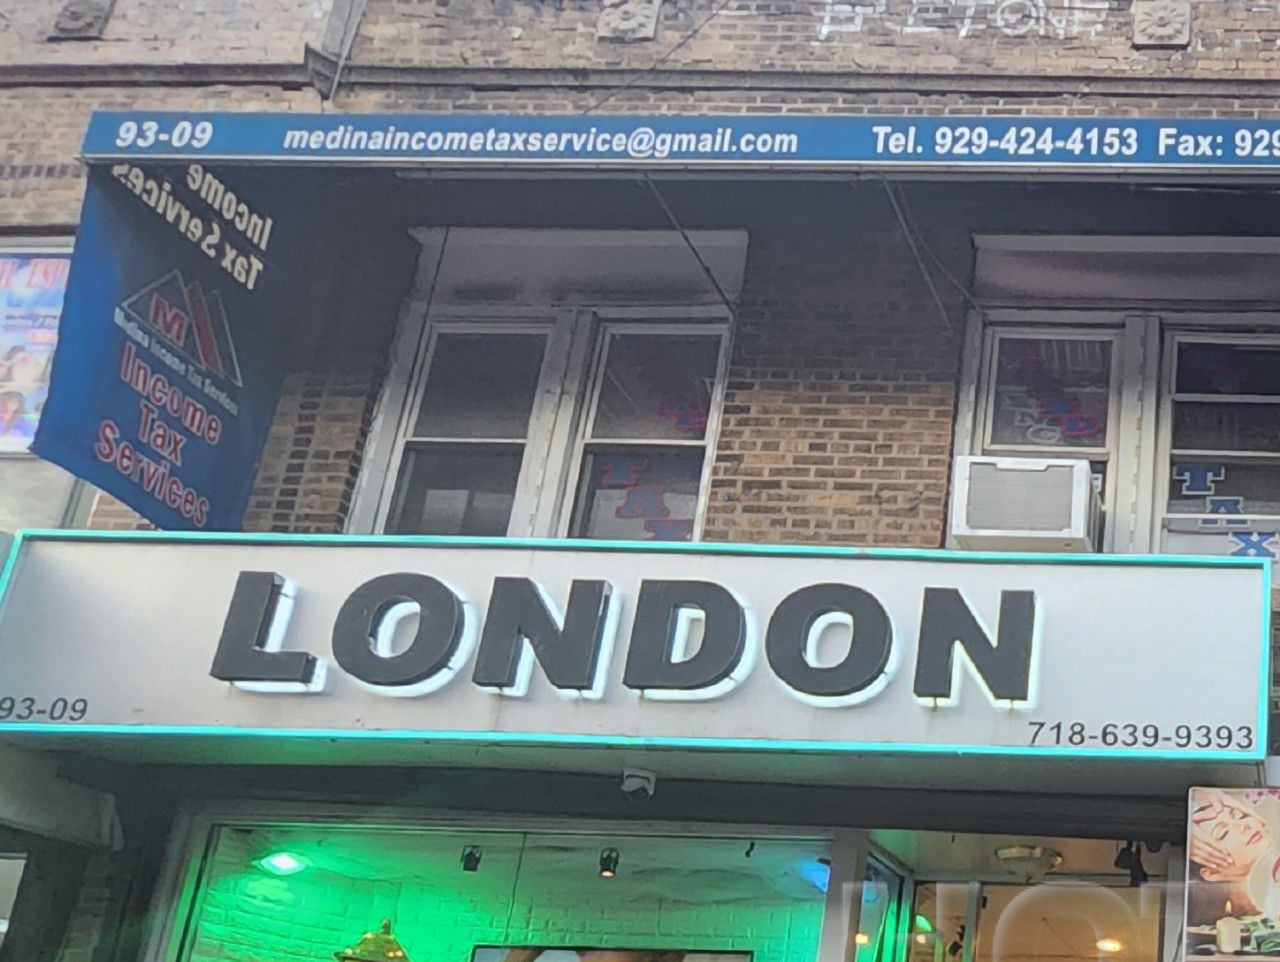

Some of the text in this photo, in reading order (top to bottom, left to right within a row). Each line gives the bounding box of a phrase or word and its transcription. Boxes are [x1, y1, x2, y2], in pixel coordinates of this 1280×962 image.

[115, 120, 214, 148] 93-09
[282, 125, 798, 157] medinaincometaxservice@gmail.com
[871, 125, 1139, 156] Tel. 929-424-4153
[1158, 127, 1225, 157] Fax:
[119, 341, 223, 445] Income
[138, 398, 187, 467] Tax
[95, 418, 210, 528] Services
[210, 571, 1043, 706] LONDON
[0, 696, 89, 722] 93-09
[1027, 721, 1254, 750] 718-639-9393
